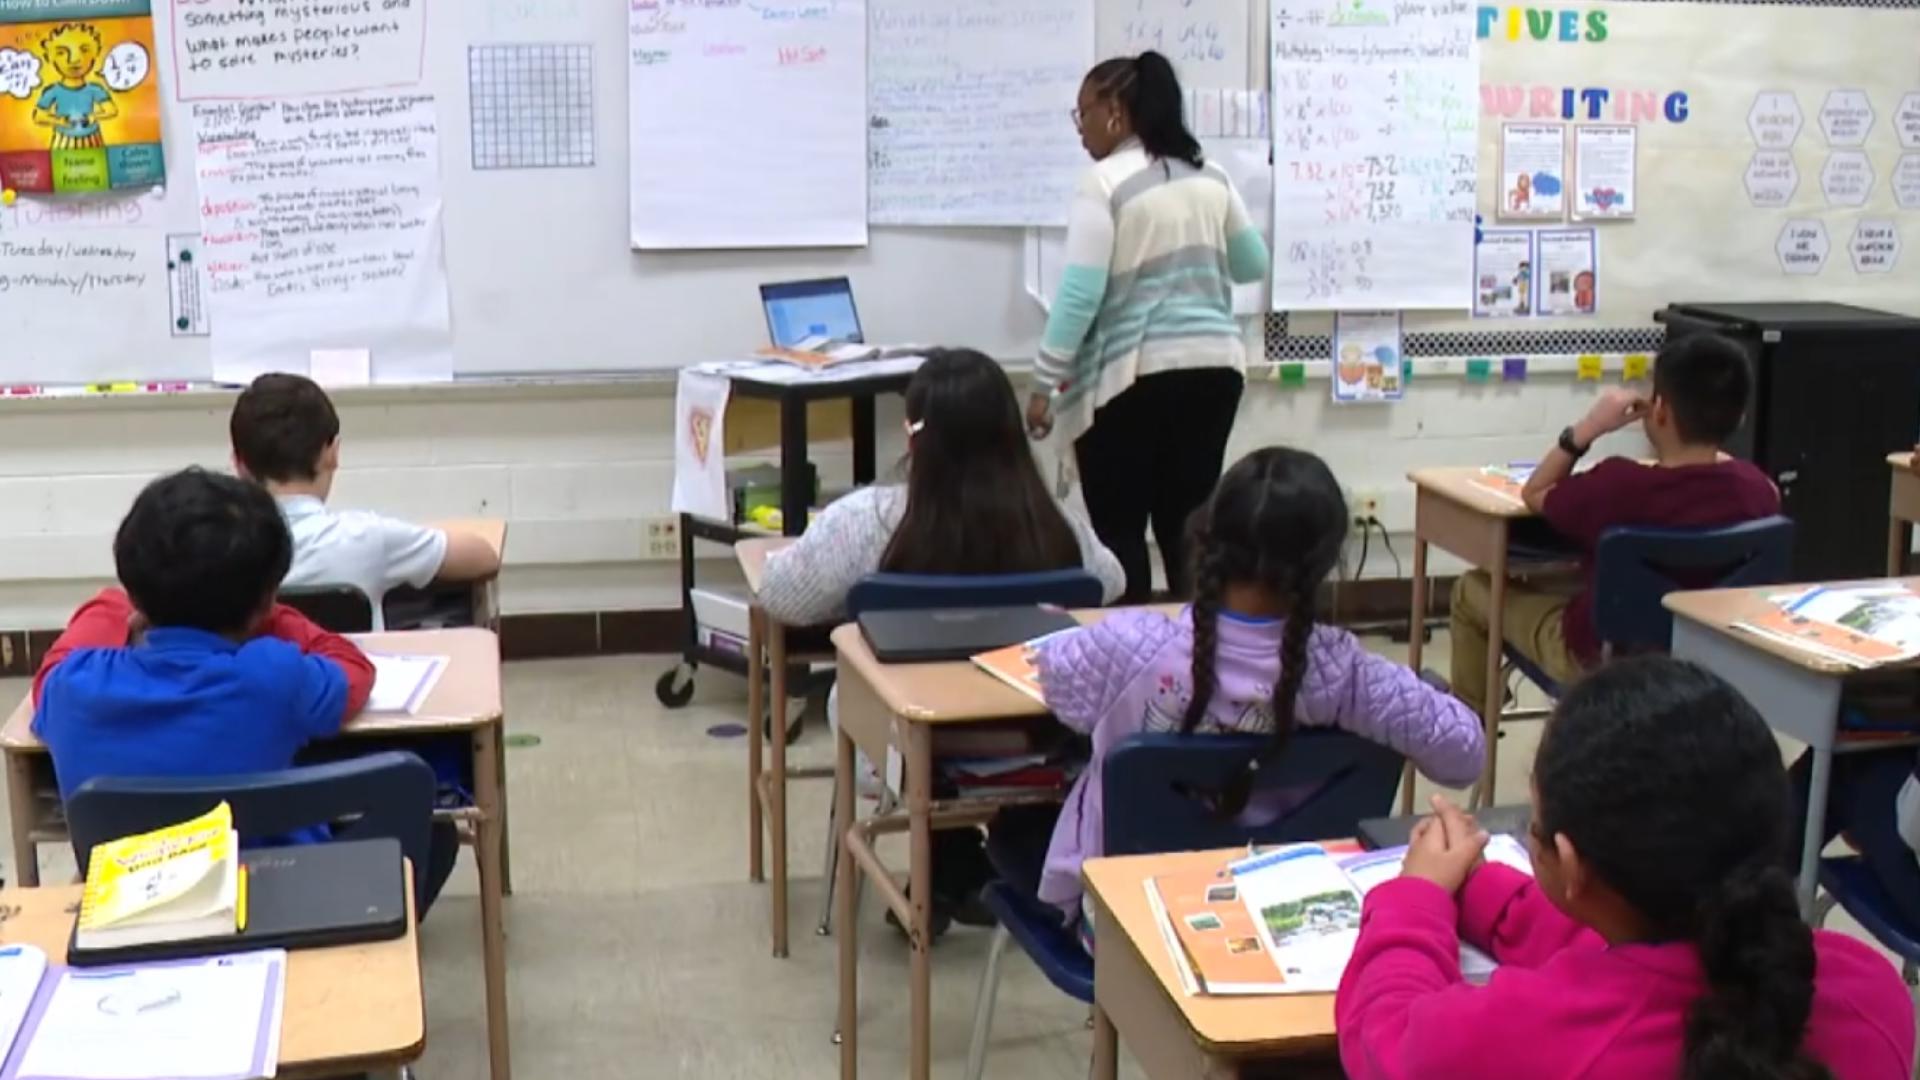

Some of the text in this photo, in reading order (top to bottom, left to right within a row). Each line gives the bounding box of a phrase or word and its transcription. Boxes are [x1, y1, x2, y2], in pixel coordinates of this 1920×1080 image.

[184, 9, 265, 27] something
[274, 2, 371, 23] mysterious
[235, 32, 287, 48] makes
[293, 26, 349, 45] people
[351, 20, 400, 37] want
[188, 55, 212, 72] to
[273, 44, 360, 64] mysteries?
[1479, 84, 1690, 123] WRITING
